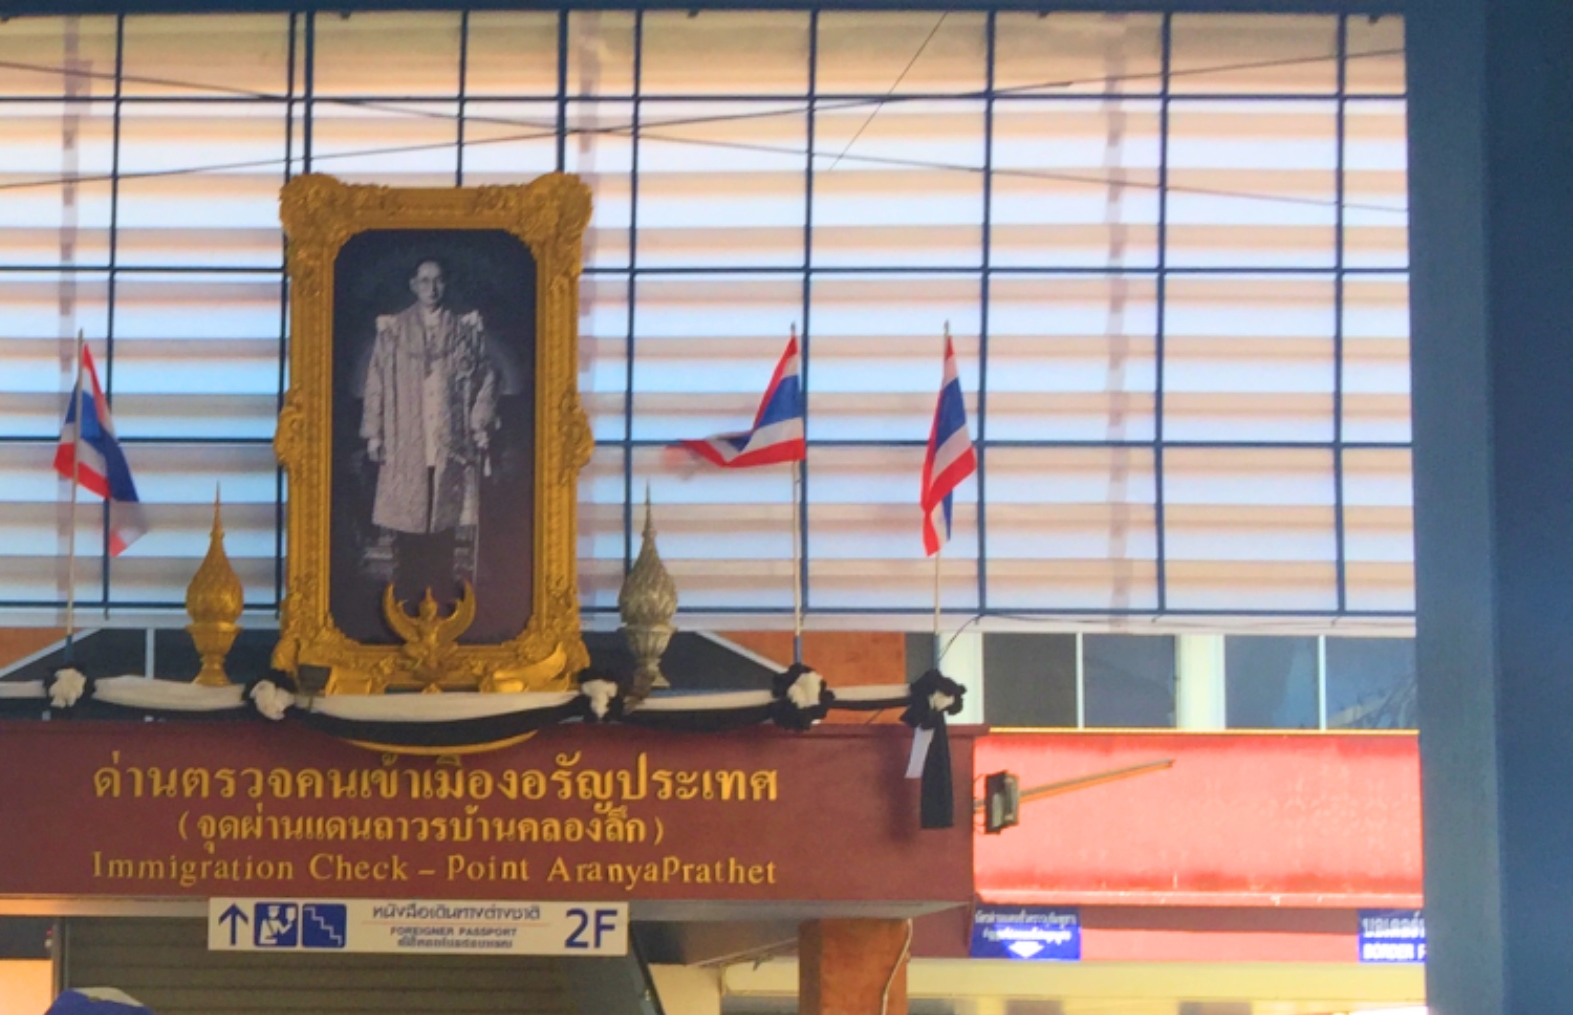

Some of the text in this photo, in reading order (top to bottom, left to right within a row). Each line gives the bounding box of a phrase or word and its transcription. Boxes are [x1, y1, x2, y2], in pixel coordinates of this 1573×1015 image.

[92, 750, 779, 802] ด่านตรวจคนเข้าเมืองอรัญประเทศ
[91, 850, 295, 887] Immigration
[308, 852, 409, 881] Check
[446, 853, 531, 882] Point
[389, 926, 518, 937] FOREIGNER PASSPORT
[563, 907, 620, 950] 2F
